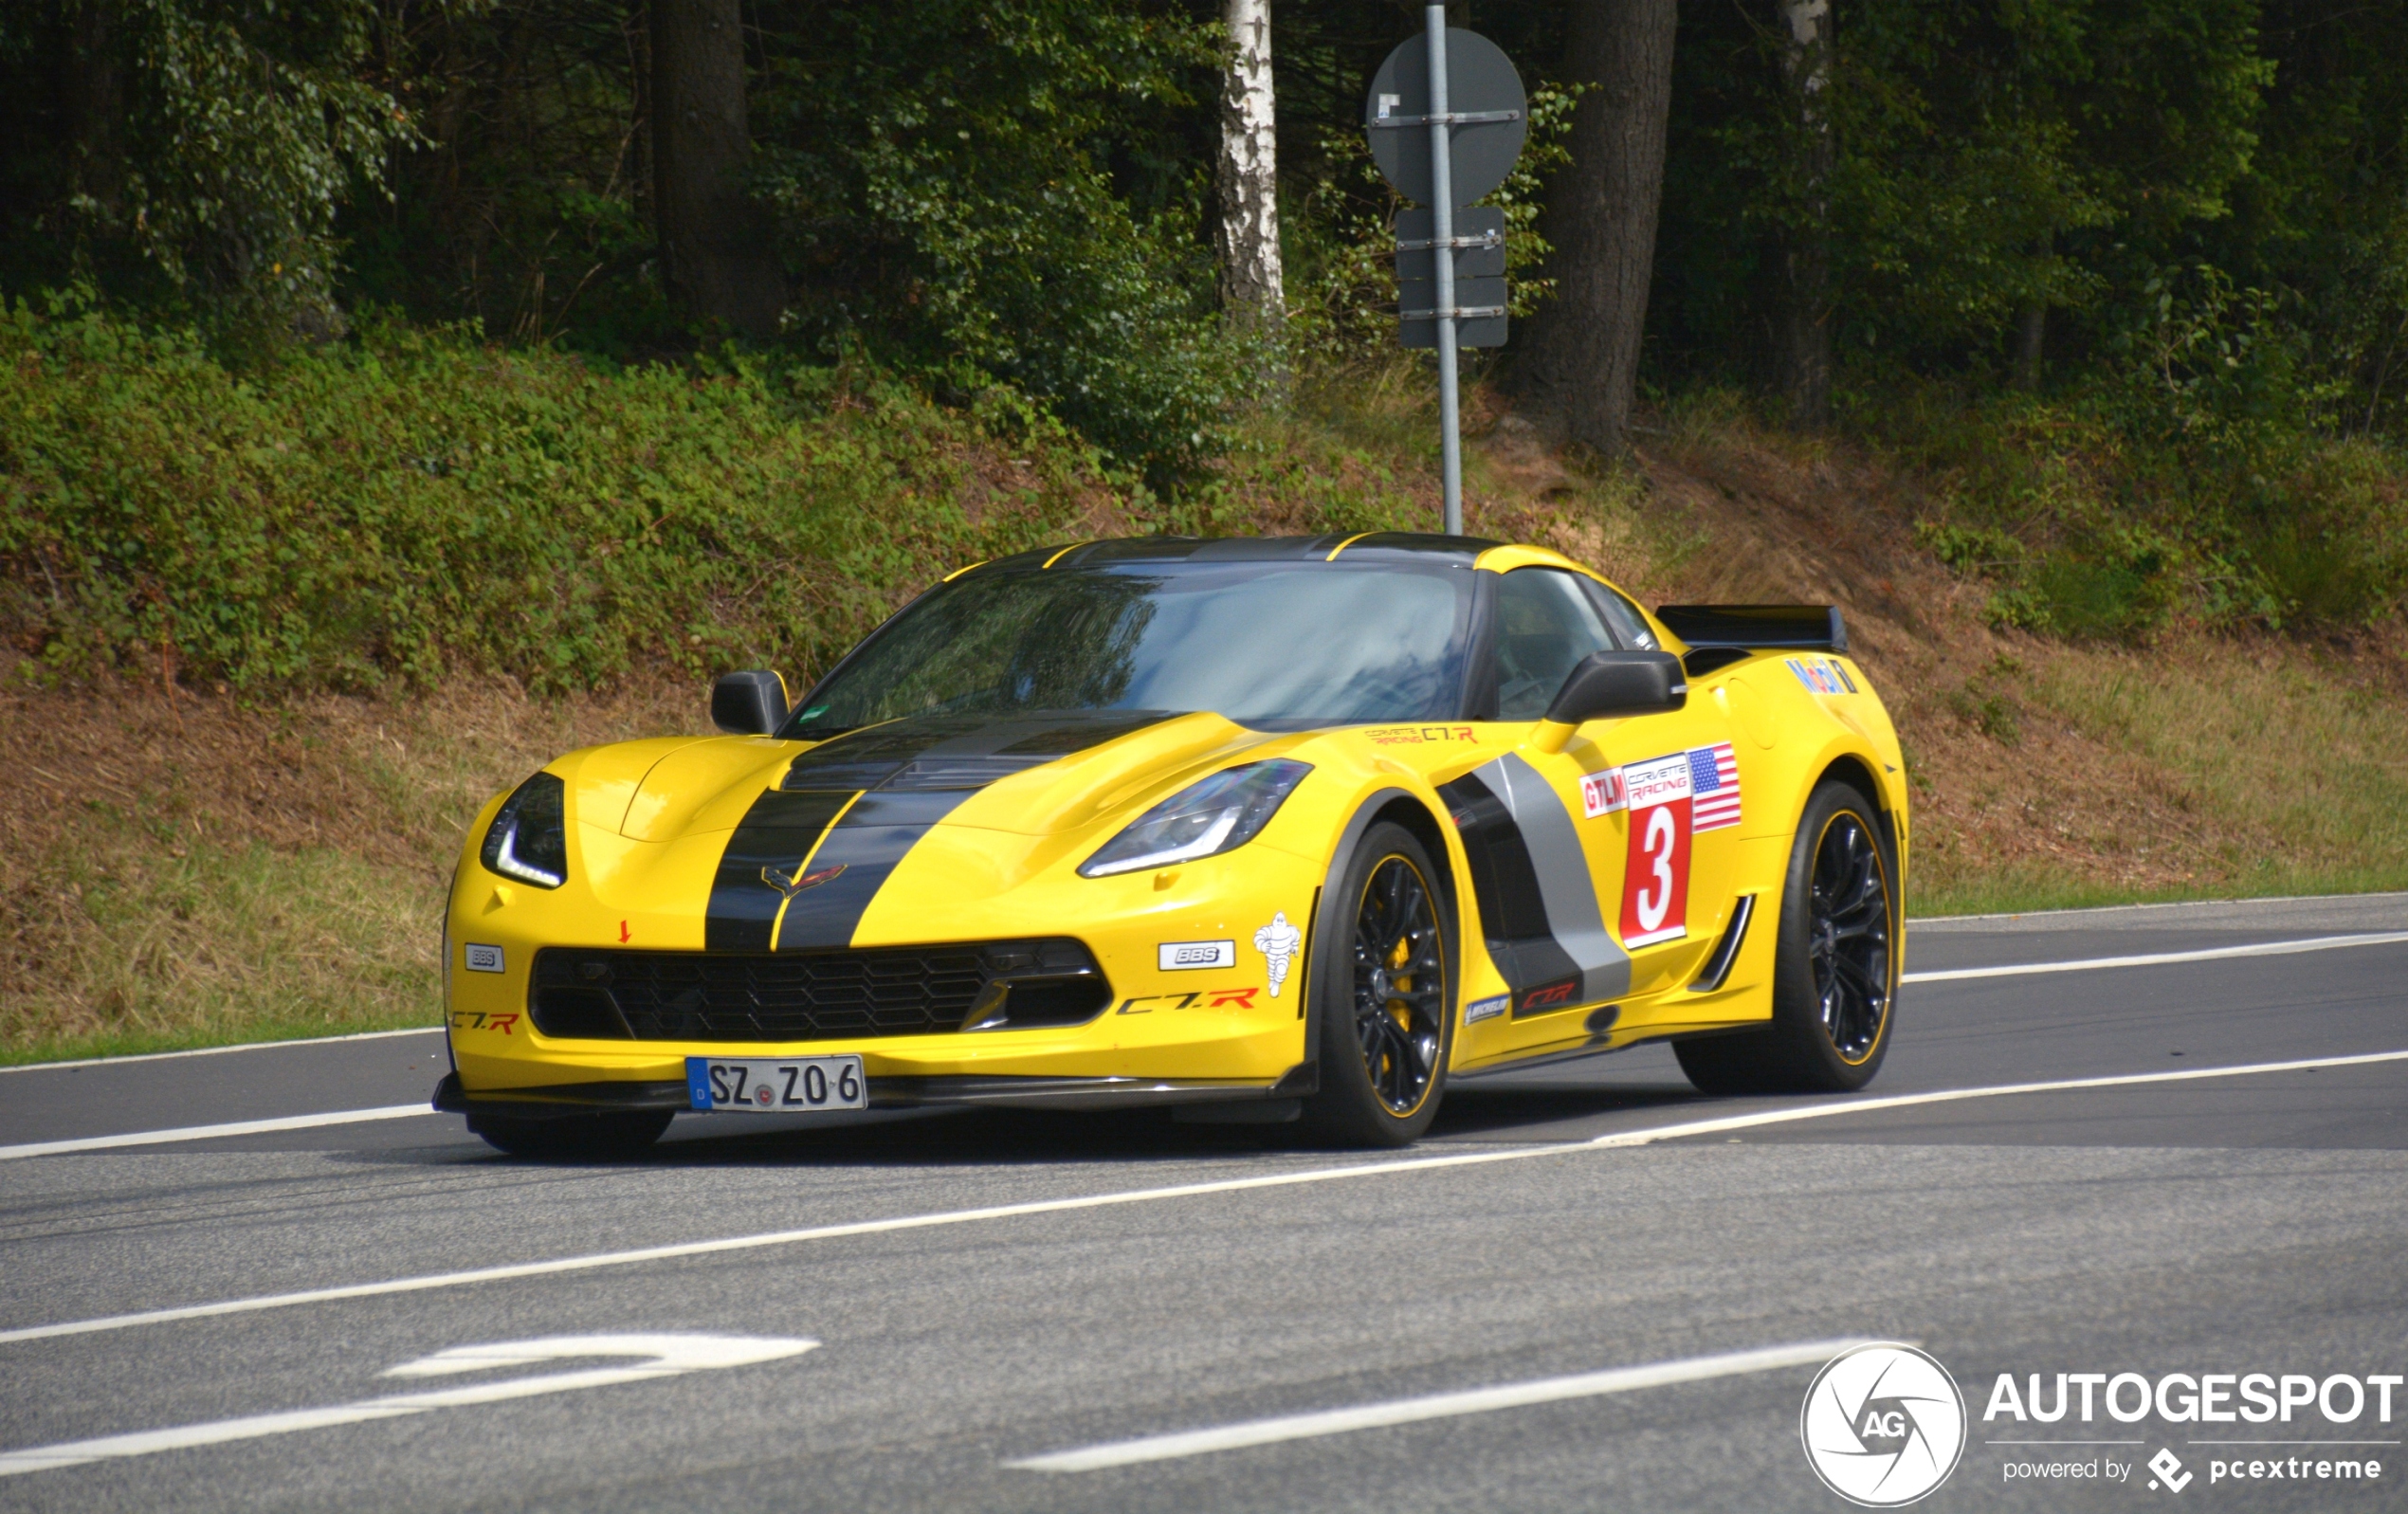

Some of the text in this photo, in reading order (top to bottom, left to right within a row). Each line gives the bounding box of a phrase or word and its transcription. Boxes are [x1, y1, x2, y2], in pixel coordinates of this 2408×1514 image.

[1628, 763, 1687, 786] CORVETTE
[1584, 774, 1627, 811] GTLM
[1628, 776, 1687, 800] RACING
[1637, 806, 1675, 932] 3
[472, 950, 496, 967] BBS
[1174, 947, 1219, 964] BBS
[1470, 998, 1509, 1018] MICHELIN
[696, 1088, 705, 1101] D
[709, 1065, 754, 1105] SZ
